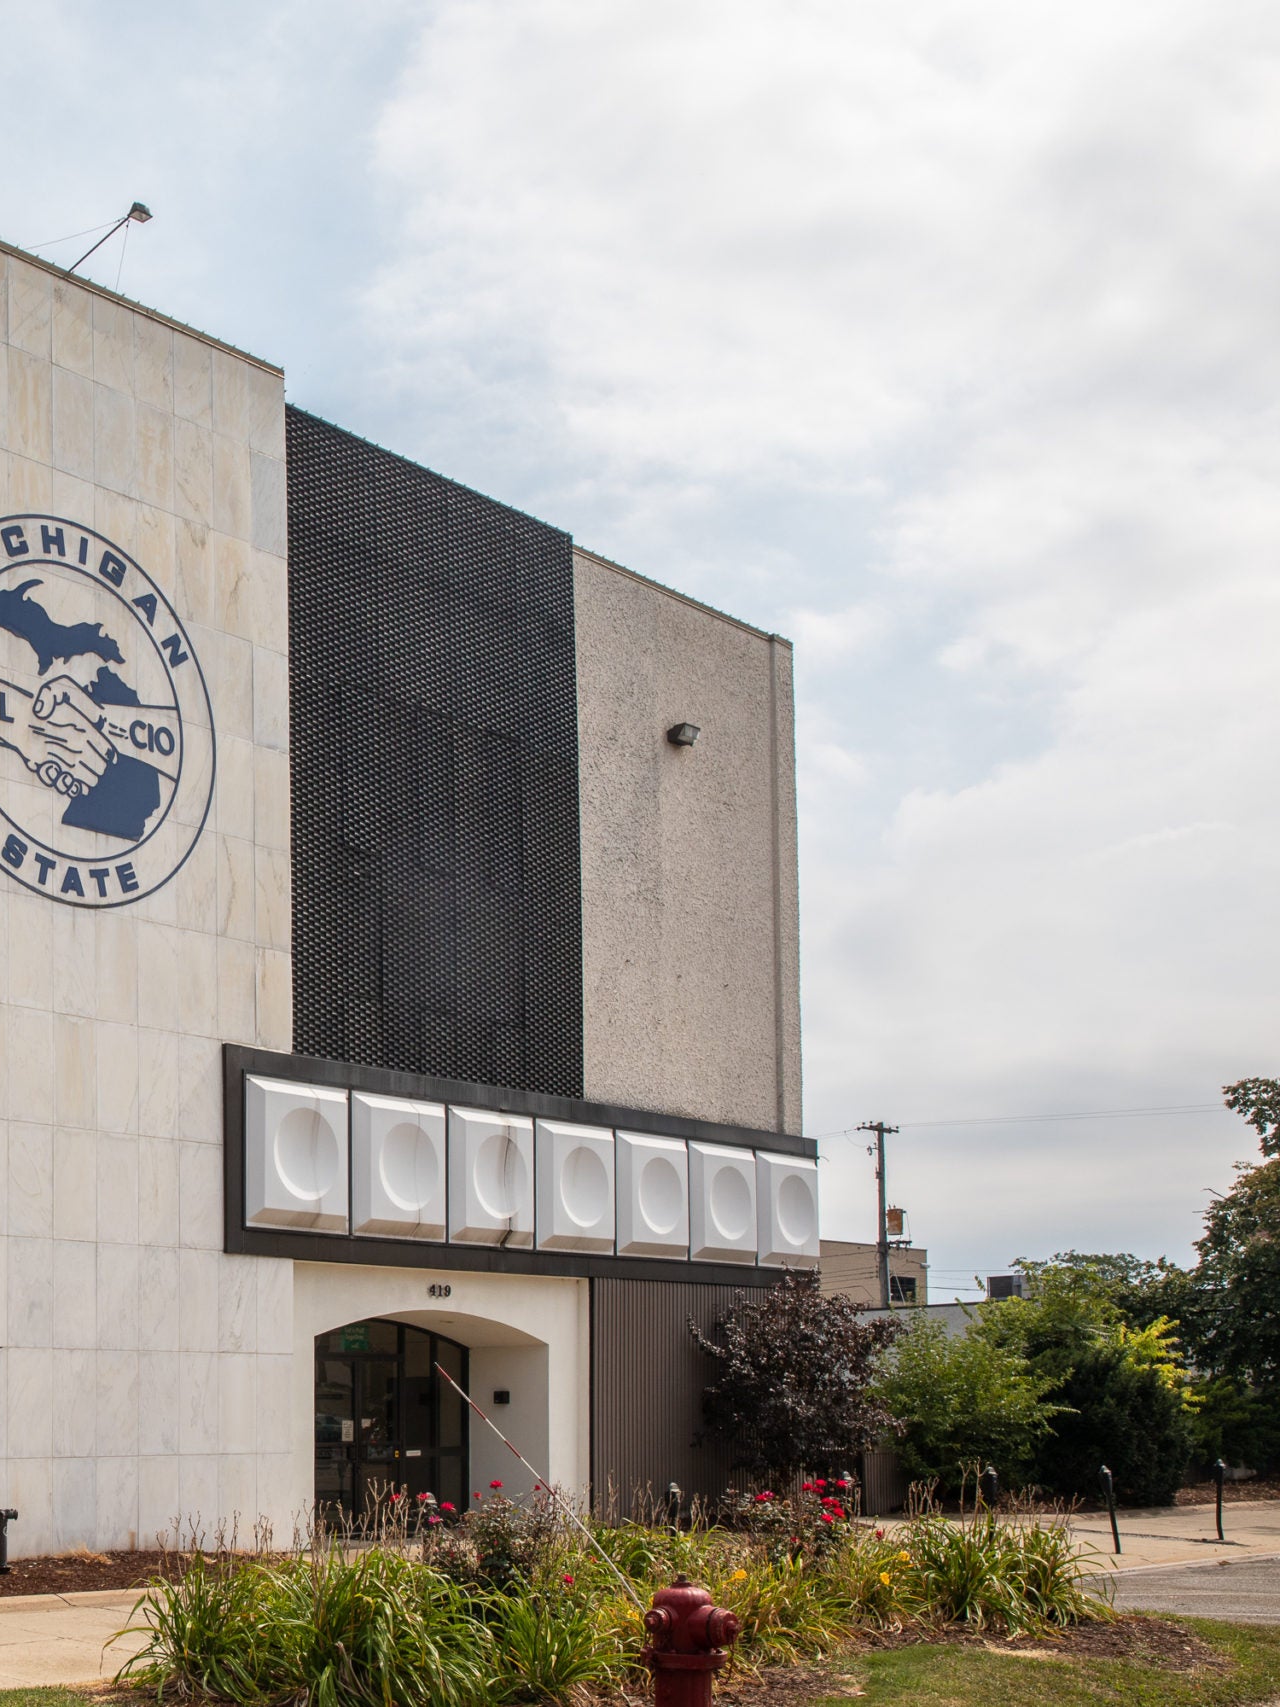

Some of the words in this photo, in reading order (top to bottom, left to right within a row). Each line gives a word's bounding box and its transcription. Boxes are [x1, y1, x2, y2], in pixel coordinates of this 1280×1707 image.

[129, 720, 175, 756] CIO
[1, 833, 140, 898] STATE
[429, 1284, 451, 1297] 419
